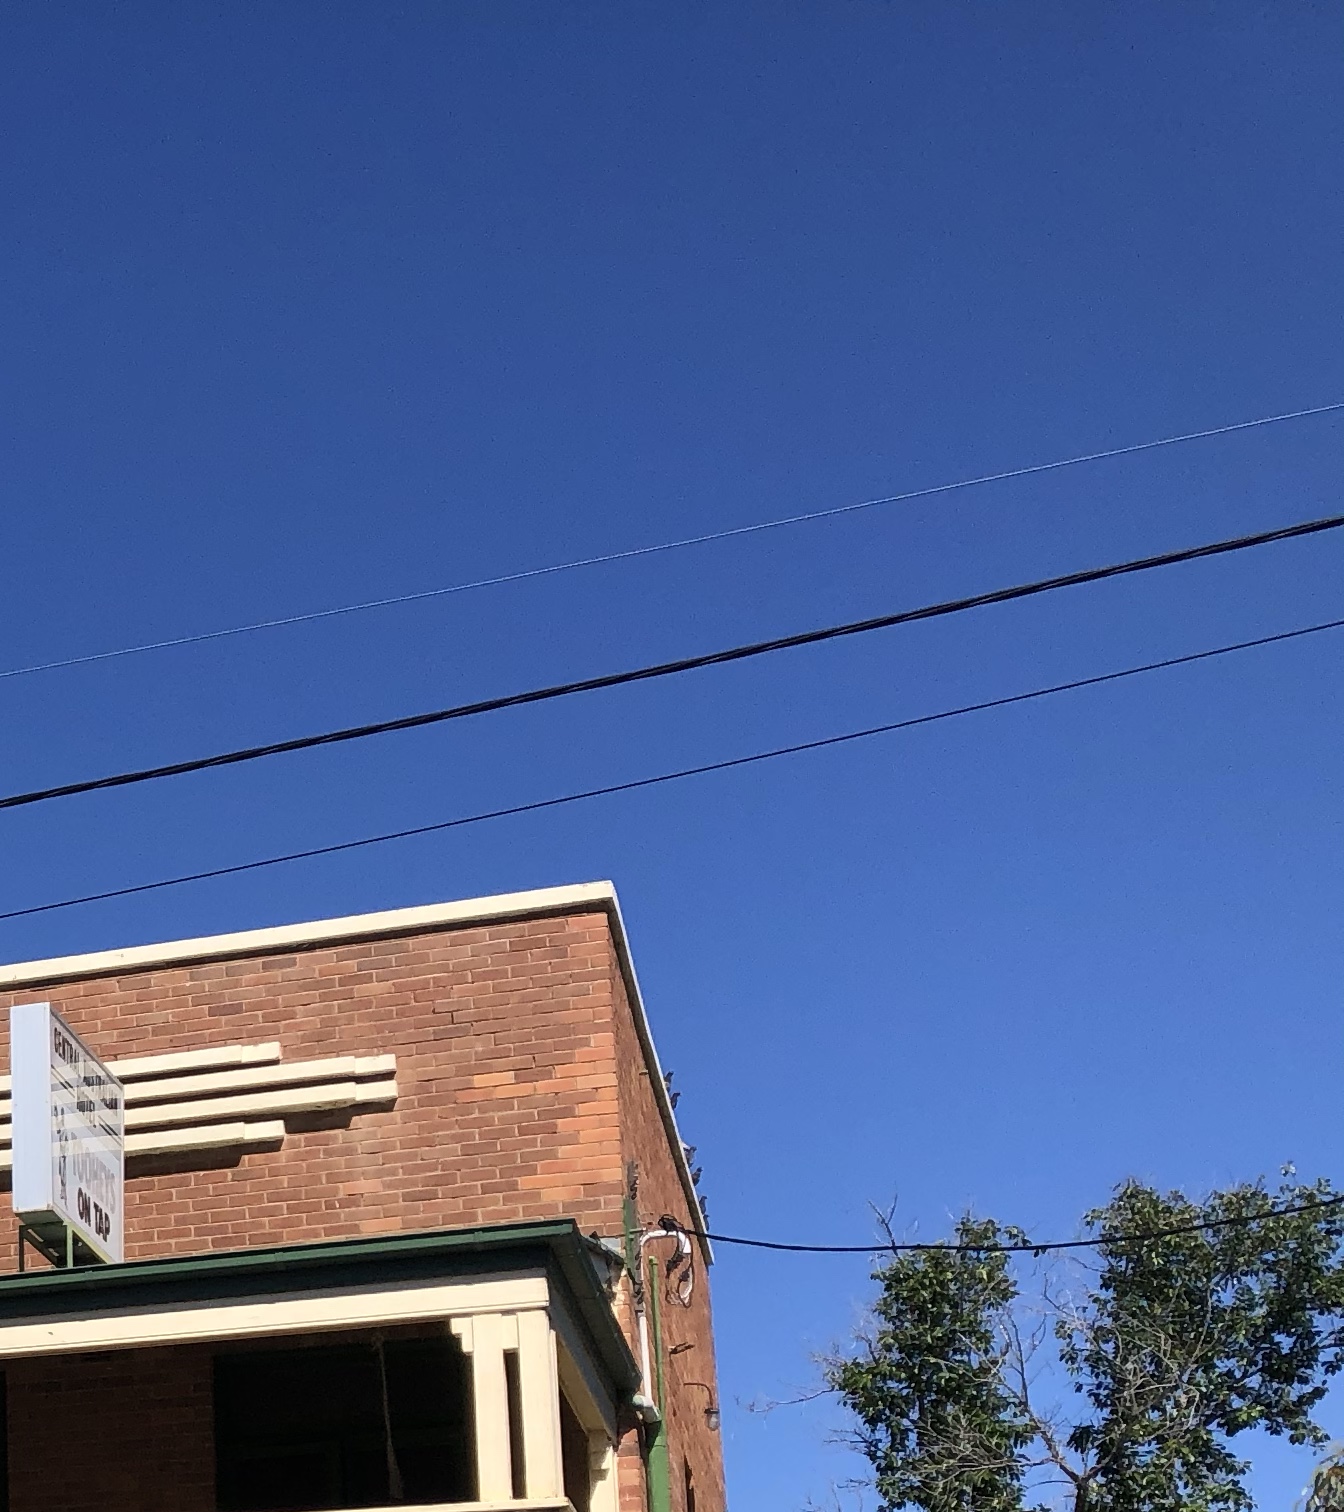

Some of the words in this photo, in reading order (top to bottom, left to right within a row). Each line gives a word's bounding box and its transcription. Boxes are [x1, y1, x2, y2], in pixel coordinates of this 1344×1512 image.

[54, 1027, 81, 1077] CENTRAL
[77, 1187, 91, 1228] ON
[93, 1201, 111, 1243] TAP
